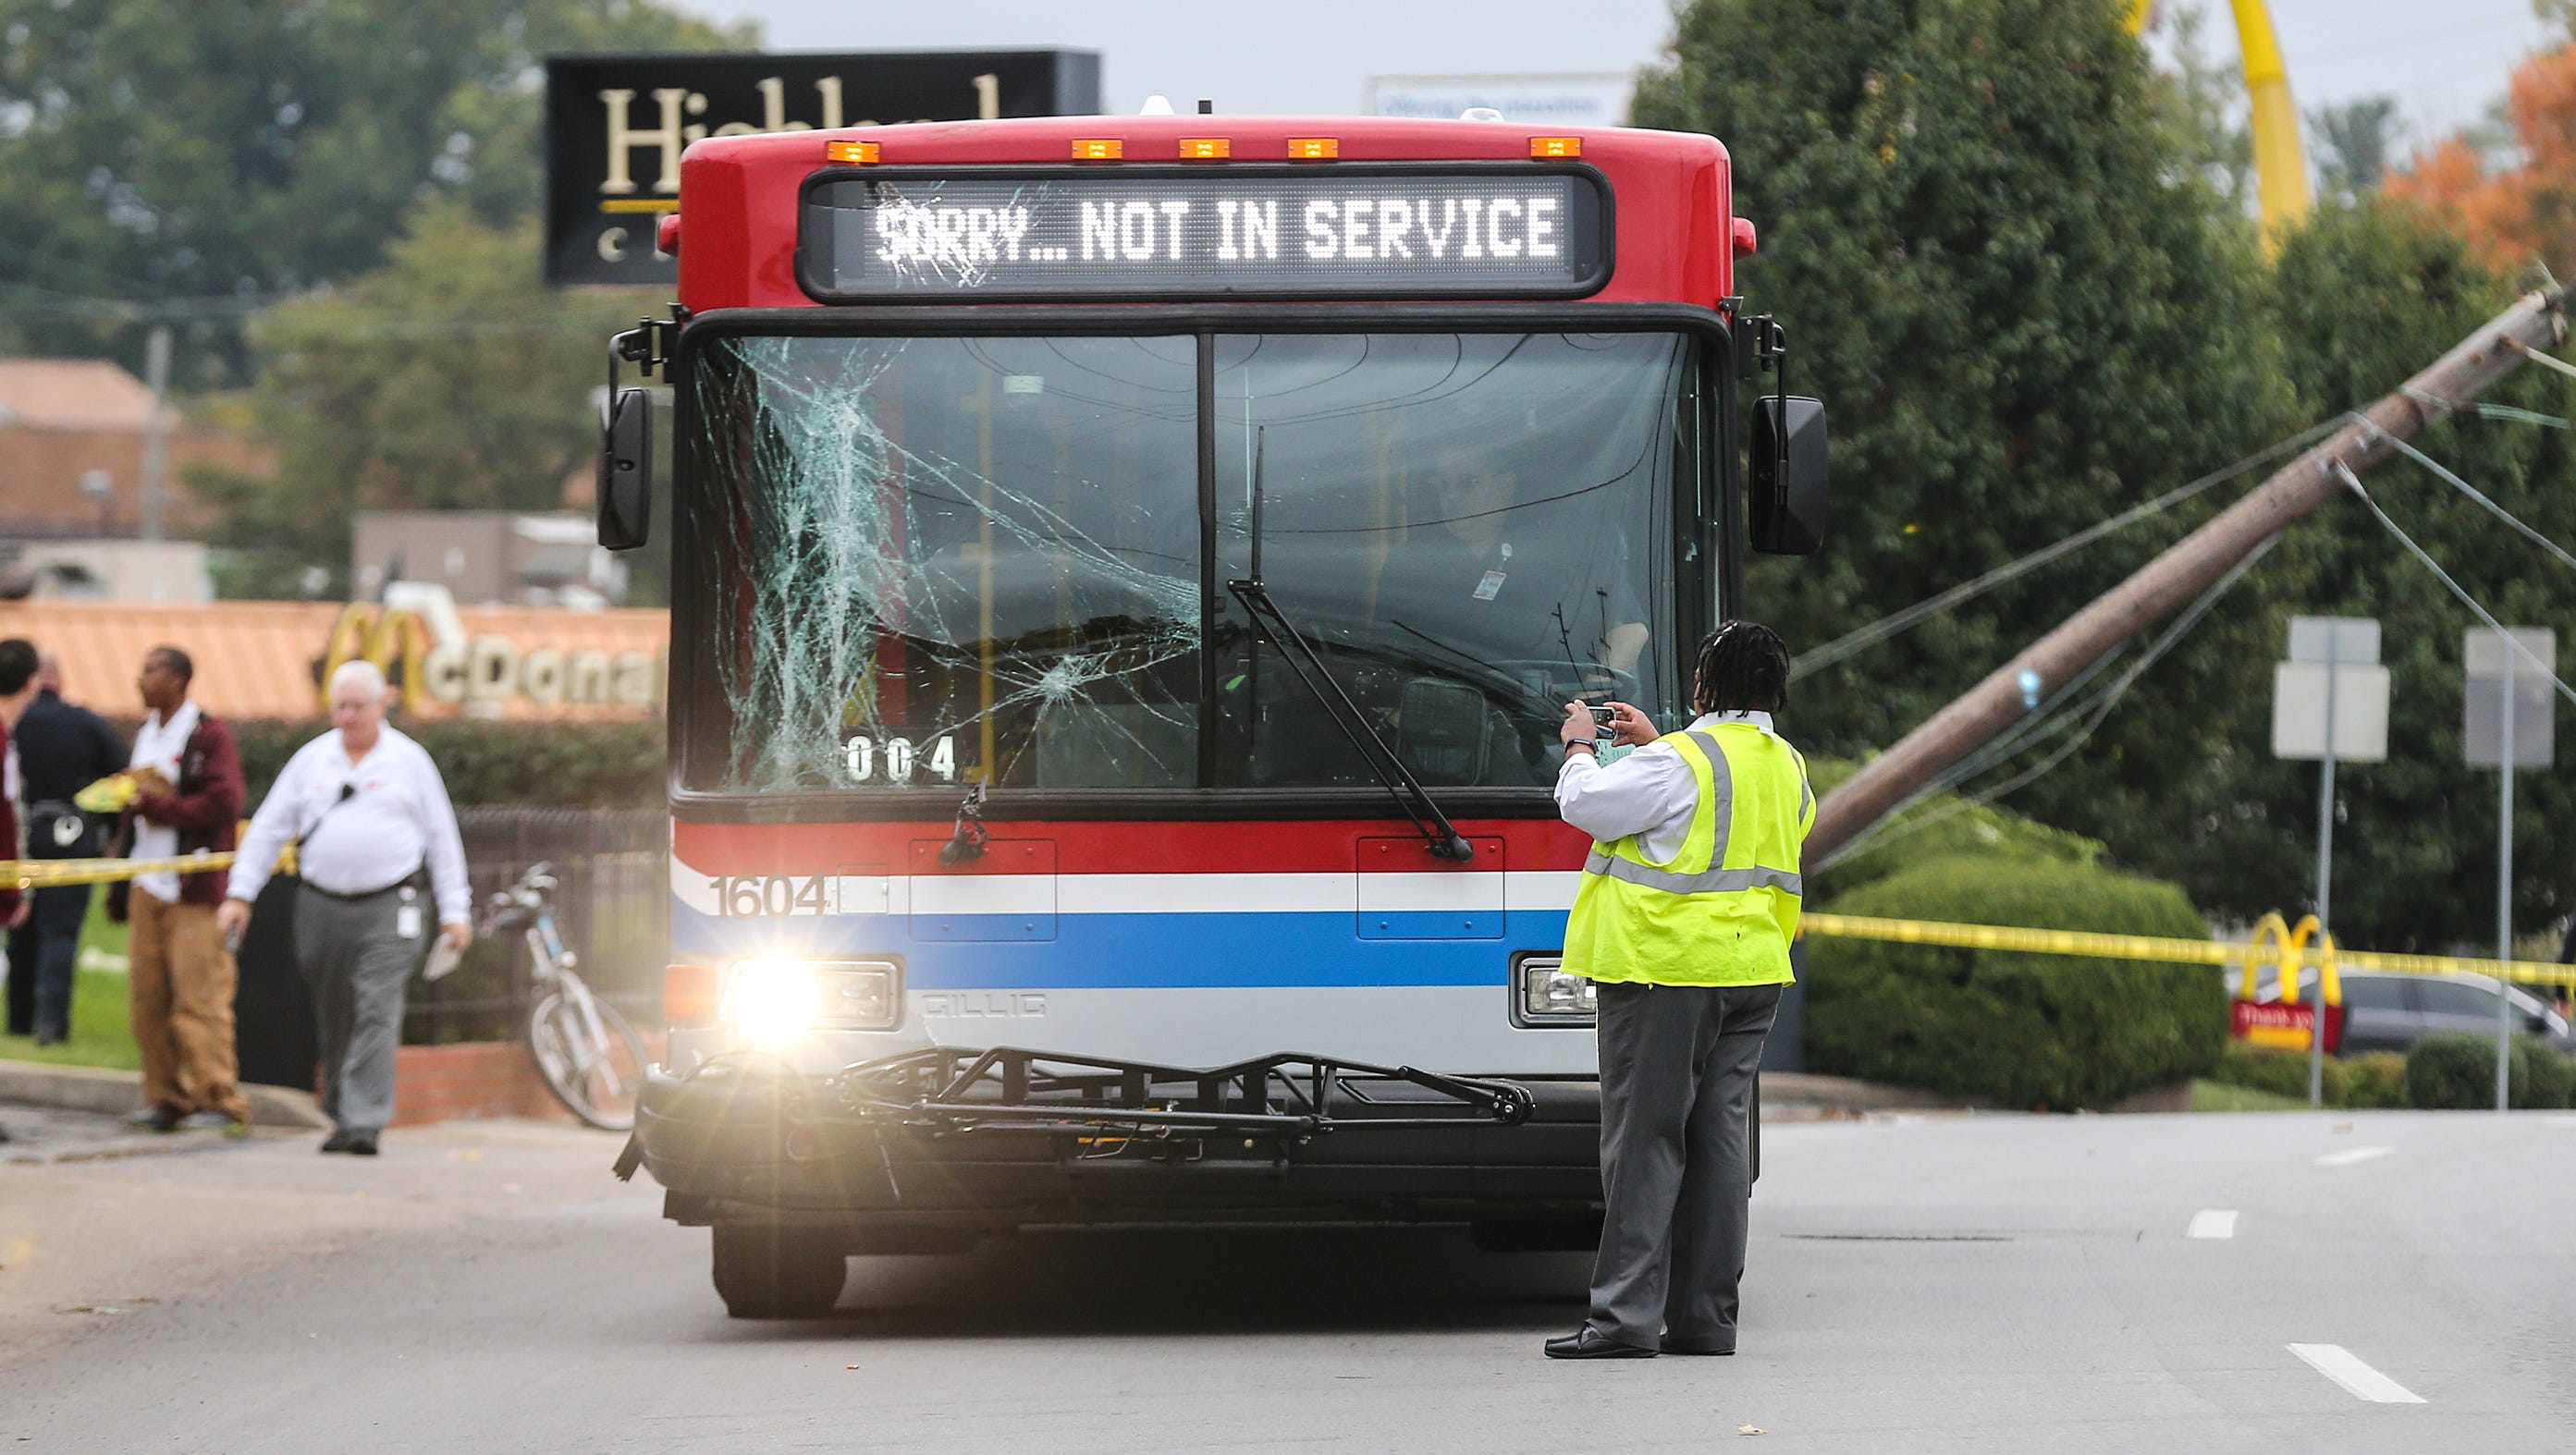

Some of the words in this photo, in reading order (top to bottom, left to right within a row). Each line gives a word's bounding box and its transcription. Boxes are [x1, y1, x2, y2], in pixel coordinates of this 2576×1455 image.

[1082, 202, 1190, 260] NOT
[1218, 201, 1278, 259] IN
[1305, 199, 1557, 258] SERVICE
[709, 873, 827, 921] 1604
[922, 993, 1046, 1018] GILLIG
